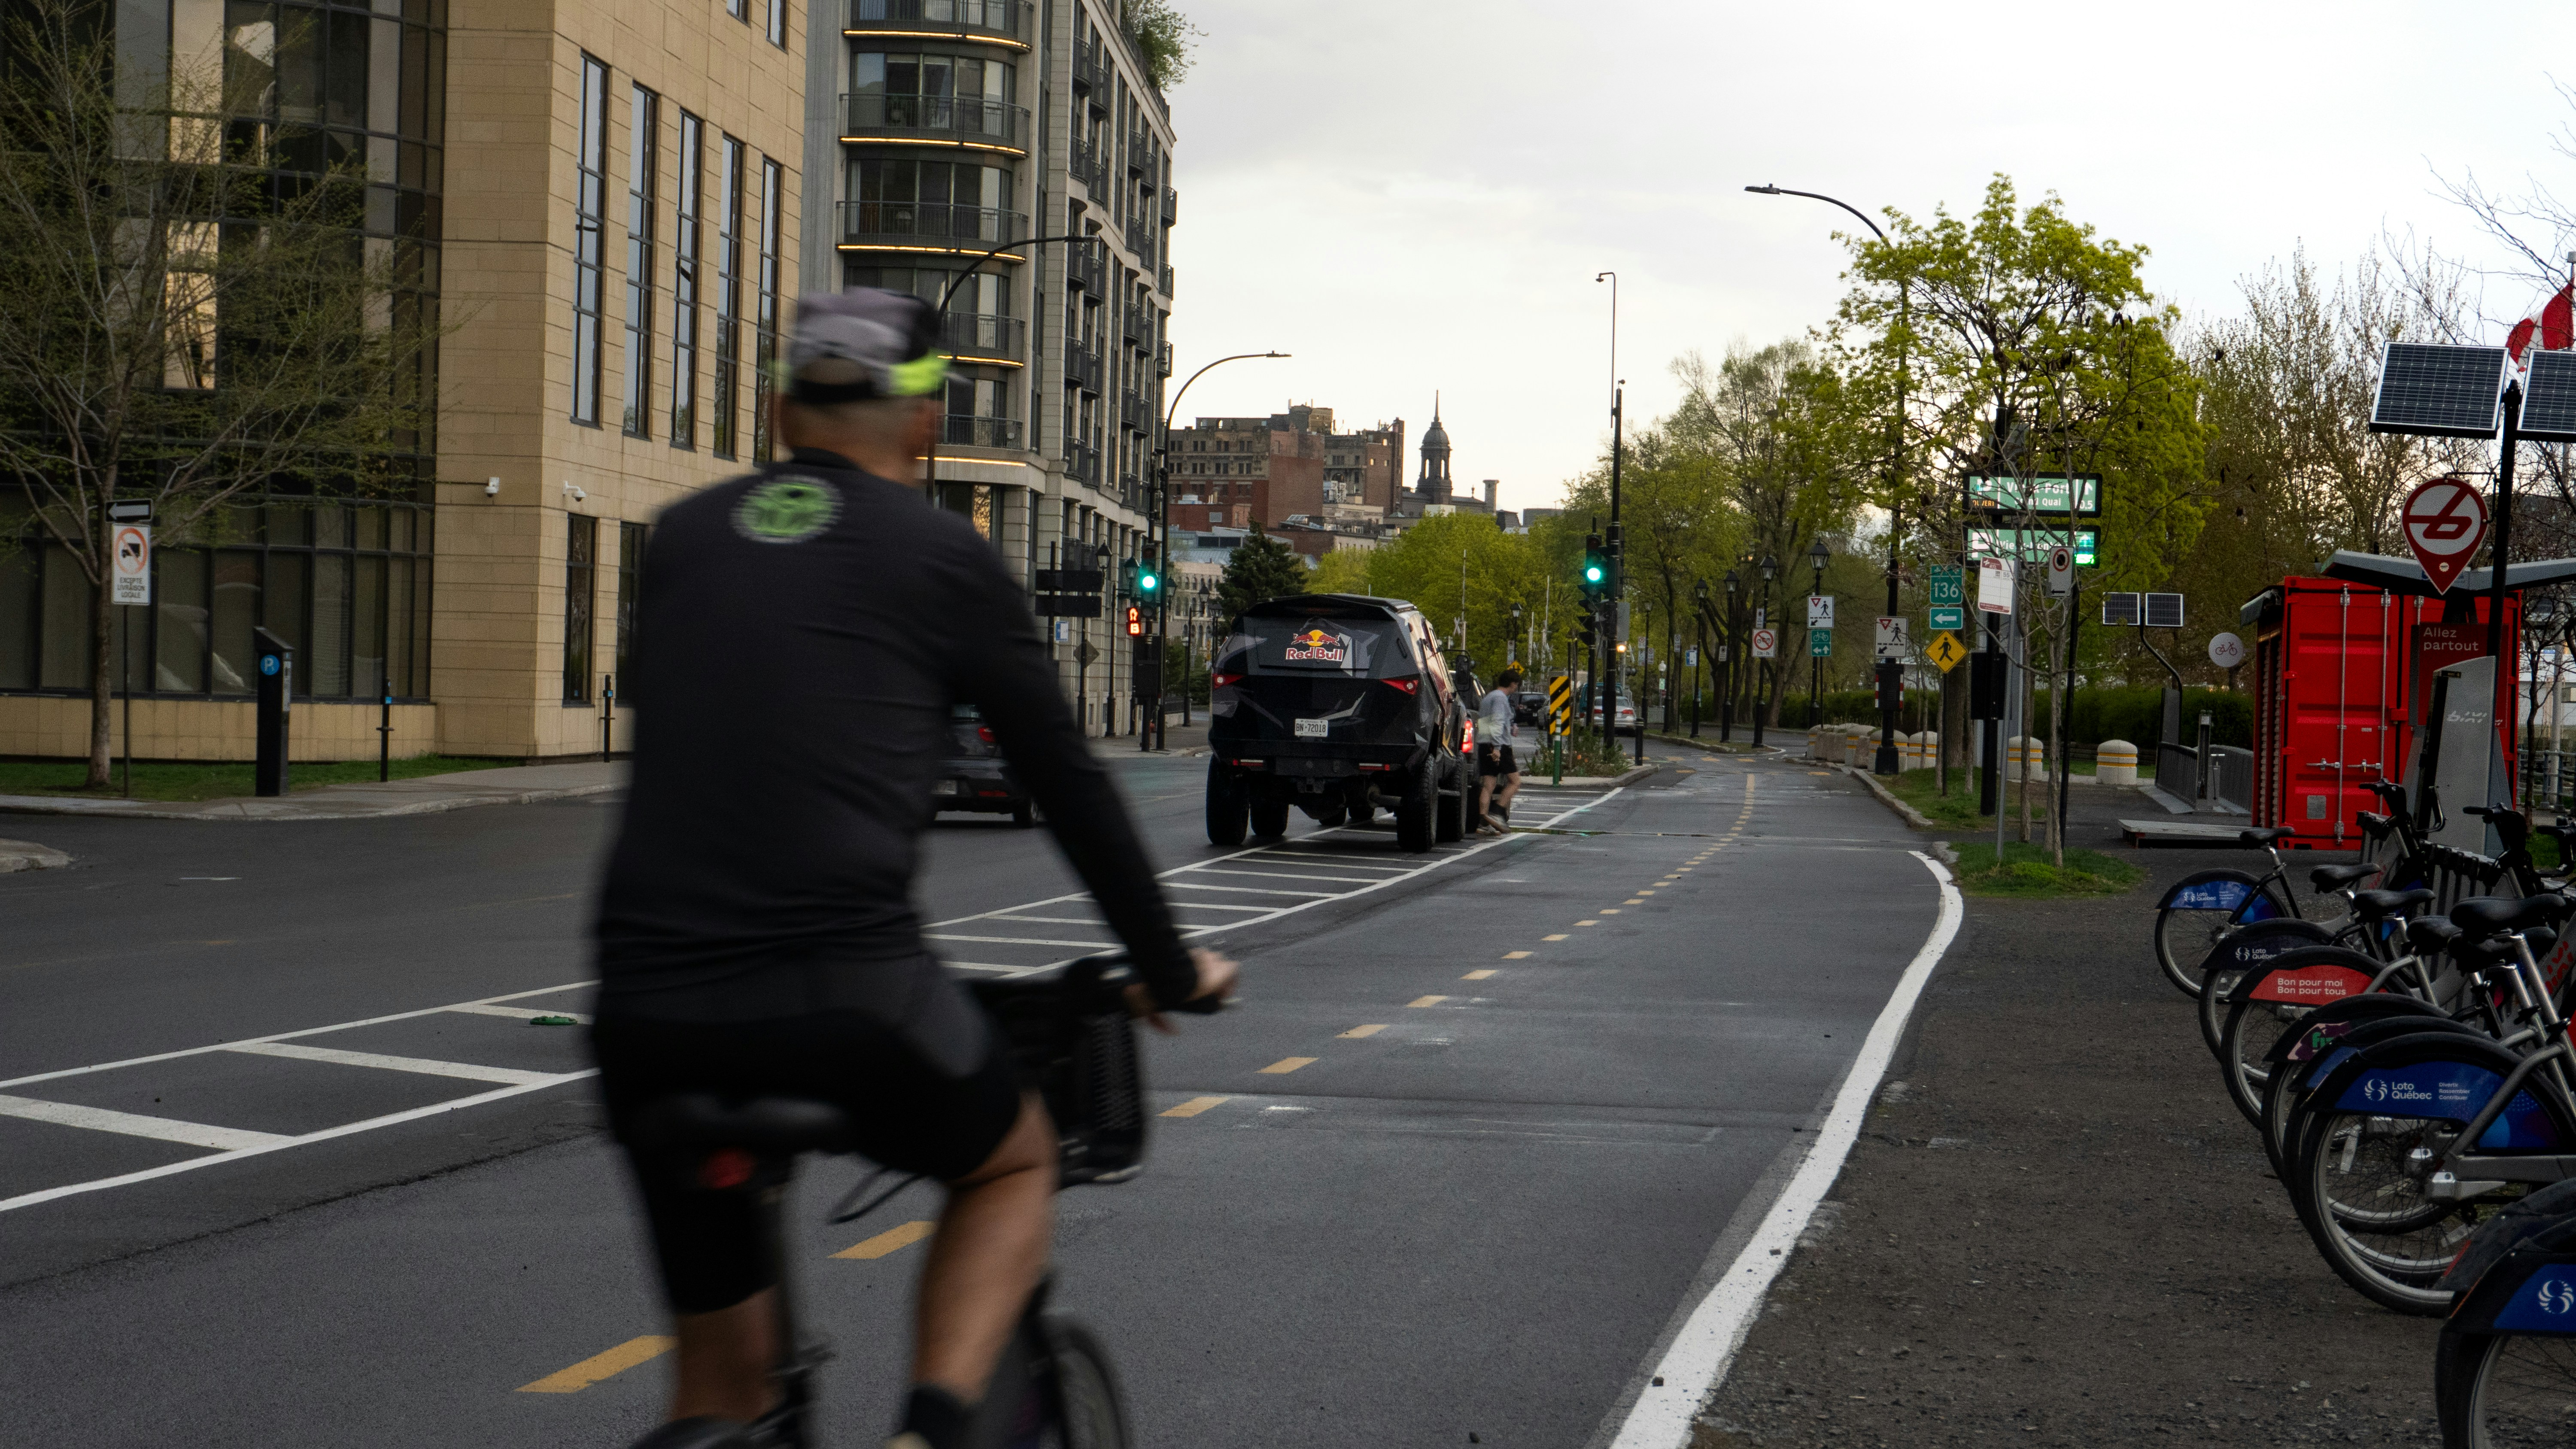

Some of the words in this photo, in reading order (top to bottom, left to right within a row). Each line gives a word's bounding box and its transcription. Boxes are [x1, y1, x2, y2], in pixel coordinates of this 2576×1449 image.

[2042, 498, 2061, 506] Quai
[1934, 582, 1959, 598] 136
[2423, 627, 2457, 638] Allez
[2423, 641, 2479, 651] partout
[1286, 647, 1314, 660] Red
[1314, 647, 1343, 661] Bull
[1296, 723, 1304, 731] BN
[1308, 723, 1326, 732] 72018
[2392, 1082, 2415, 1090] Loto
[2391, 1090, 2432, 1100] Québec
